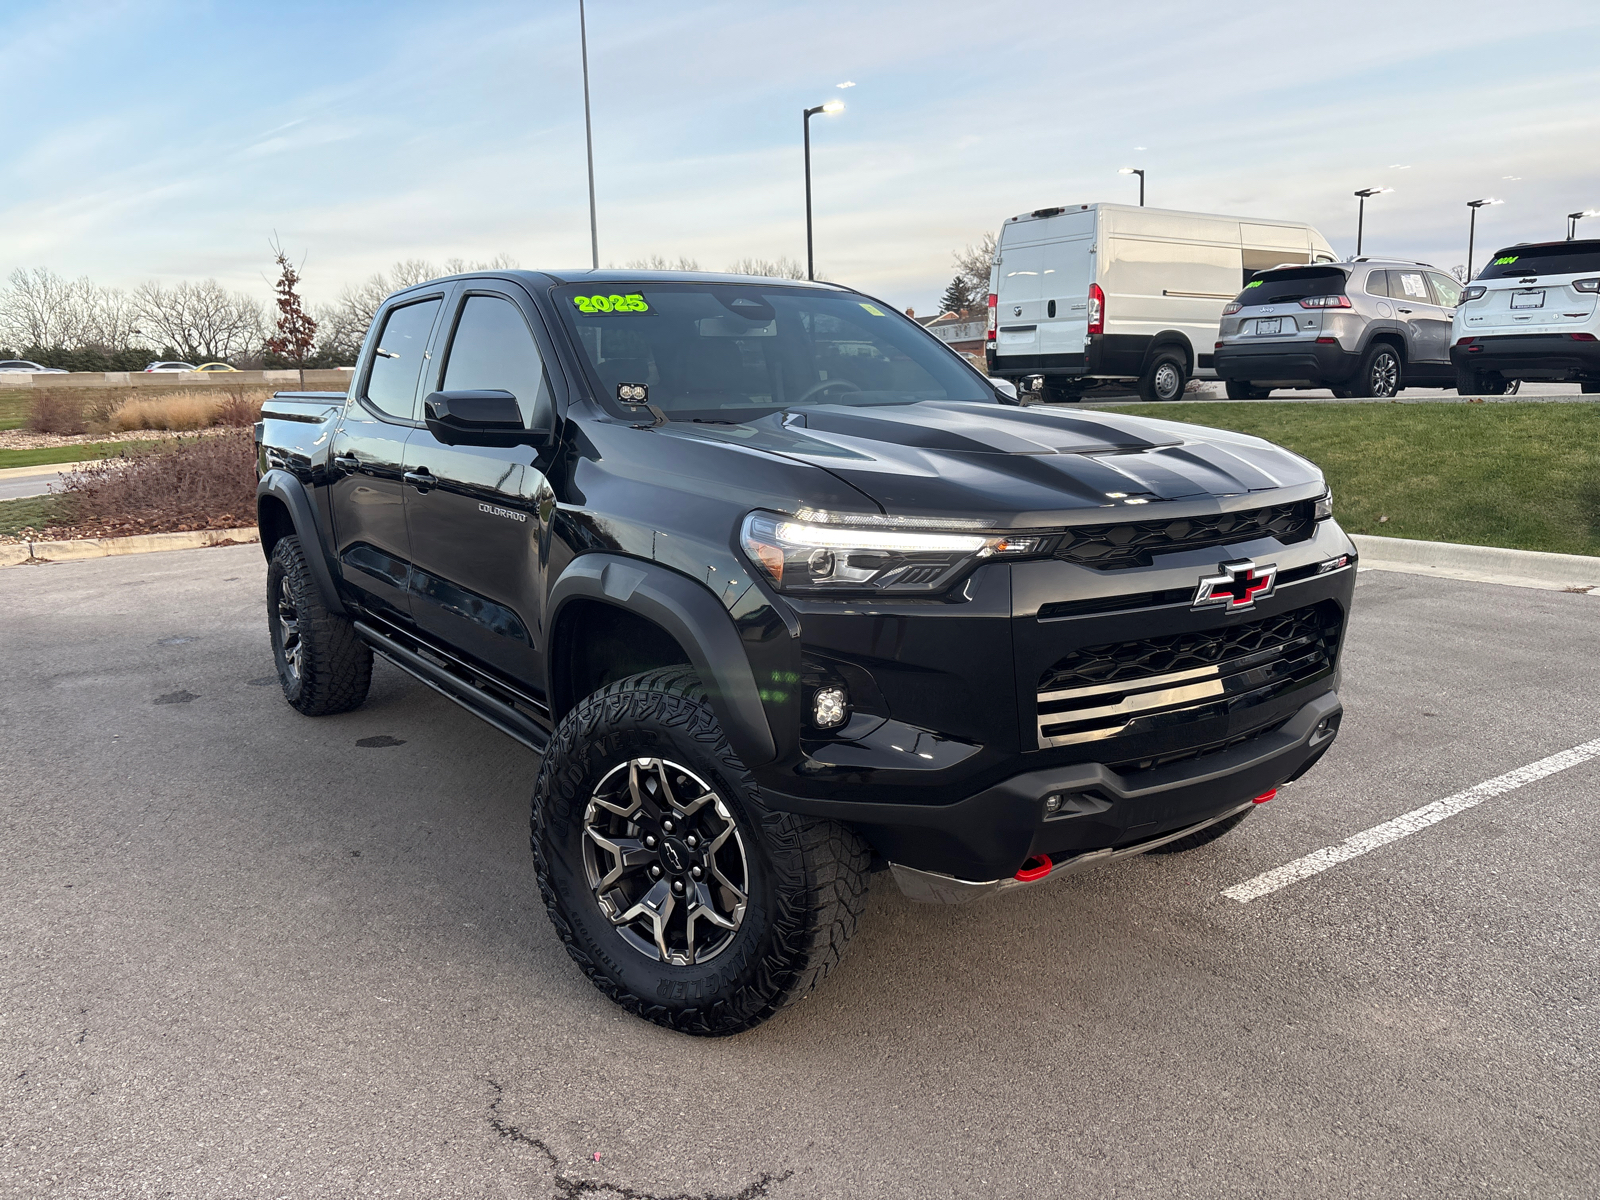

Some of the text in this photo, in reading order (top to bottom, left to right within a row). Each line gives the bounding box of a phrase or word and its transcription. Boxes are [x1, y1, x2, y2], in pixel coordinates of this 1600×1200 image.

[574, 294, 649, 313] 2025
[478, 503, 527, 522] COLORADO
[656, 903, 767, 1000] WRANGLER
